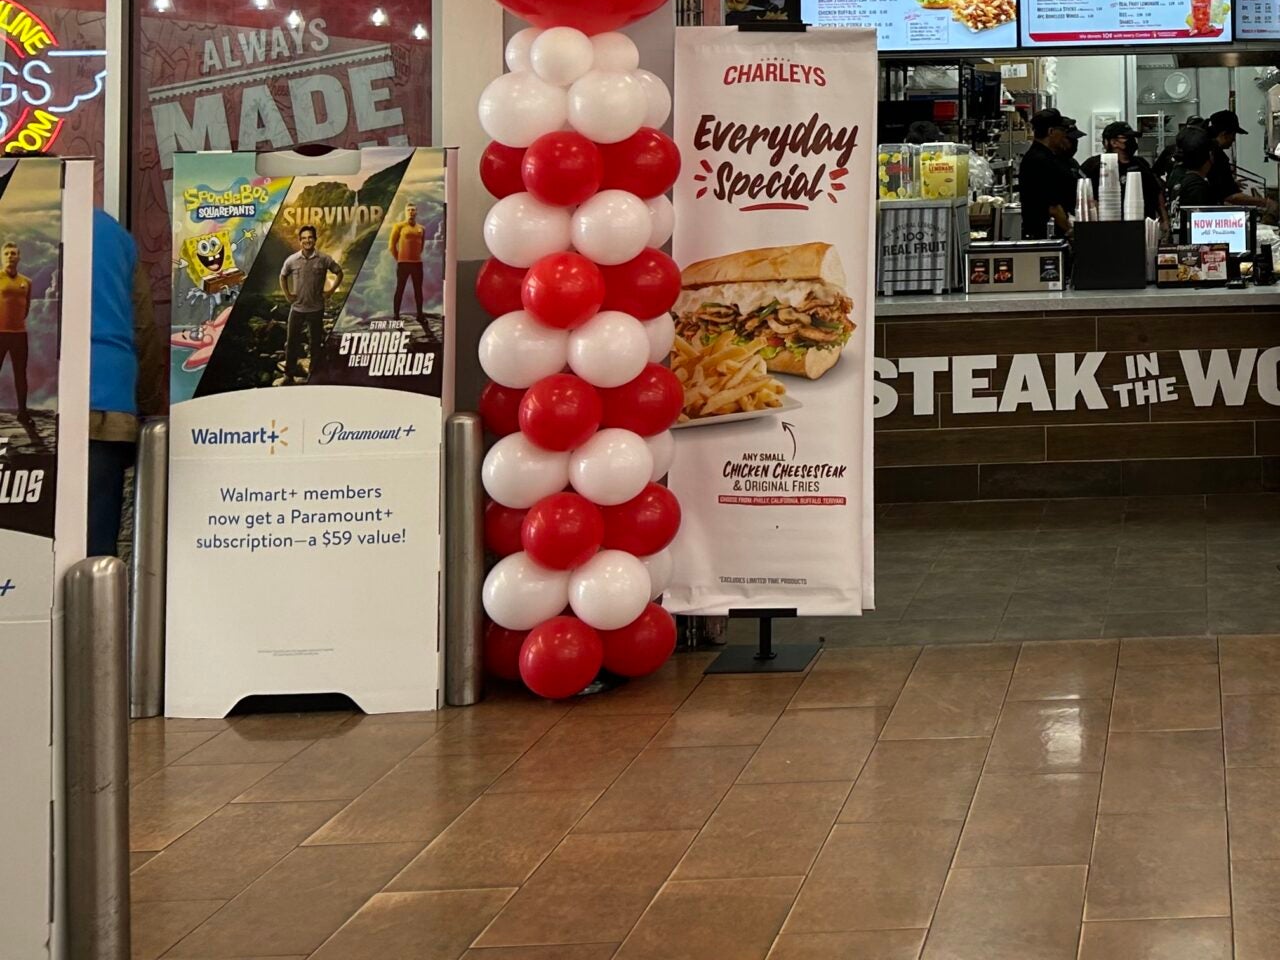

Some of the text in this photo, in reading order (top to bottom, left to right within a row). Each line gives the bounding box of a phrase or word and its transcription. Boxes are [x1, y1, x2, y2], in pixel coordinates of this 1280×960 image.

[202, 17, 330, 75] ALWAYS
[723, 63, 826, 87] CHARLEYS
[150, 60, 405, 170] MADE
[694, 112, 859, 168] Everyday
[713, 161, 826, 204] Special
[184, 185, 269, 212] SpongeBob
[198, 205, 255, 219] SQUAREPANTS
[282, 205, 385, 227] SURVIVOR
[1194, 219, 1243, 229] NOW HIRING
[883, 241, 946, 256] REAL FRUIT
[370, 320, 405, 330] STAR TREK
[339, 331, 411, 355] STRANGE
[368, 353, 435, 376] WORLDS
[1125, 352, 1159, 379] IN
[874, 351, 1109, 418] STEAK
[1112, 377, 1179, 407] THE
[318, 421, 416, 445] Paramount+
[742, 453, 786, 462] ANY SMALL
[723, 461, 847, 480] CHICKEN CHEESESTEAK
[220, 485, 382, 502] Walmart+ members
[733, 480, 820, 492] & ORIGINAL FRIES
[208, 508, 393, 529] now get a Paramount+
[322, 530, 352, 548] $59
[357, 528, 406, 545] value!
